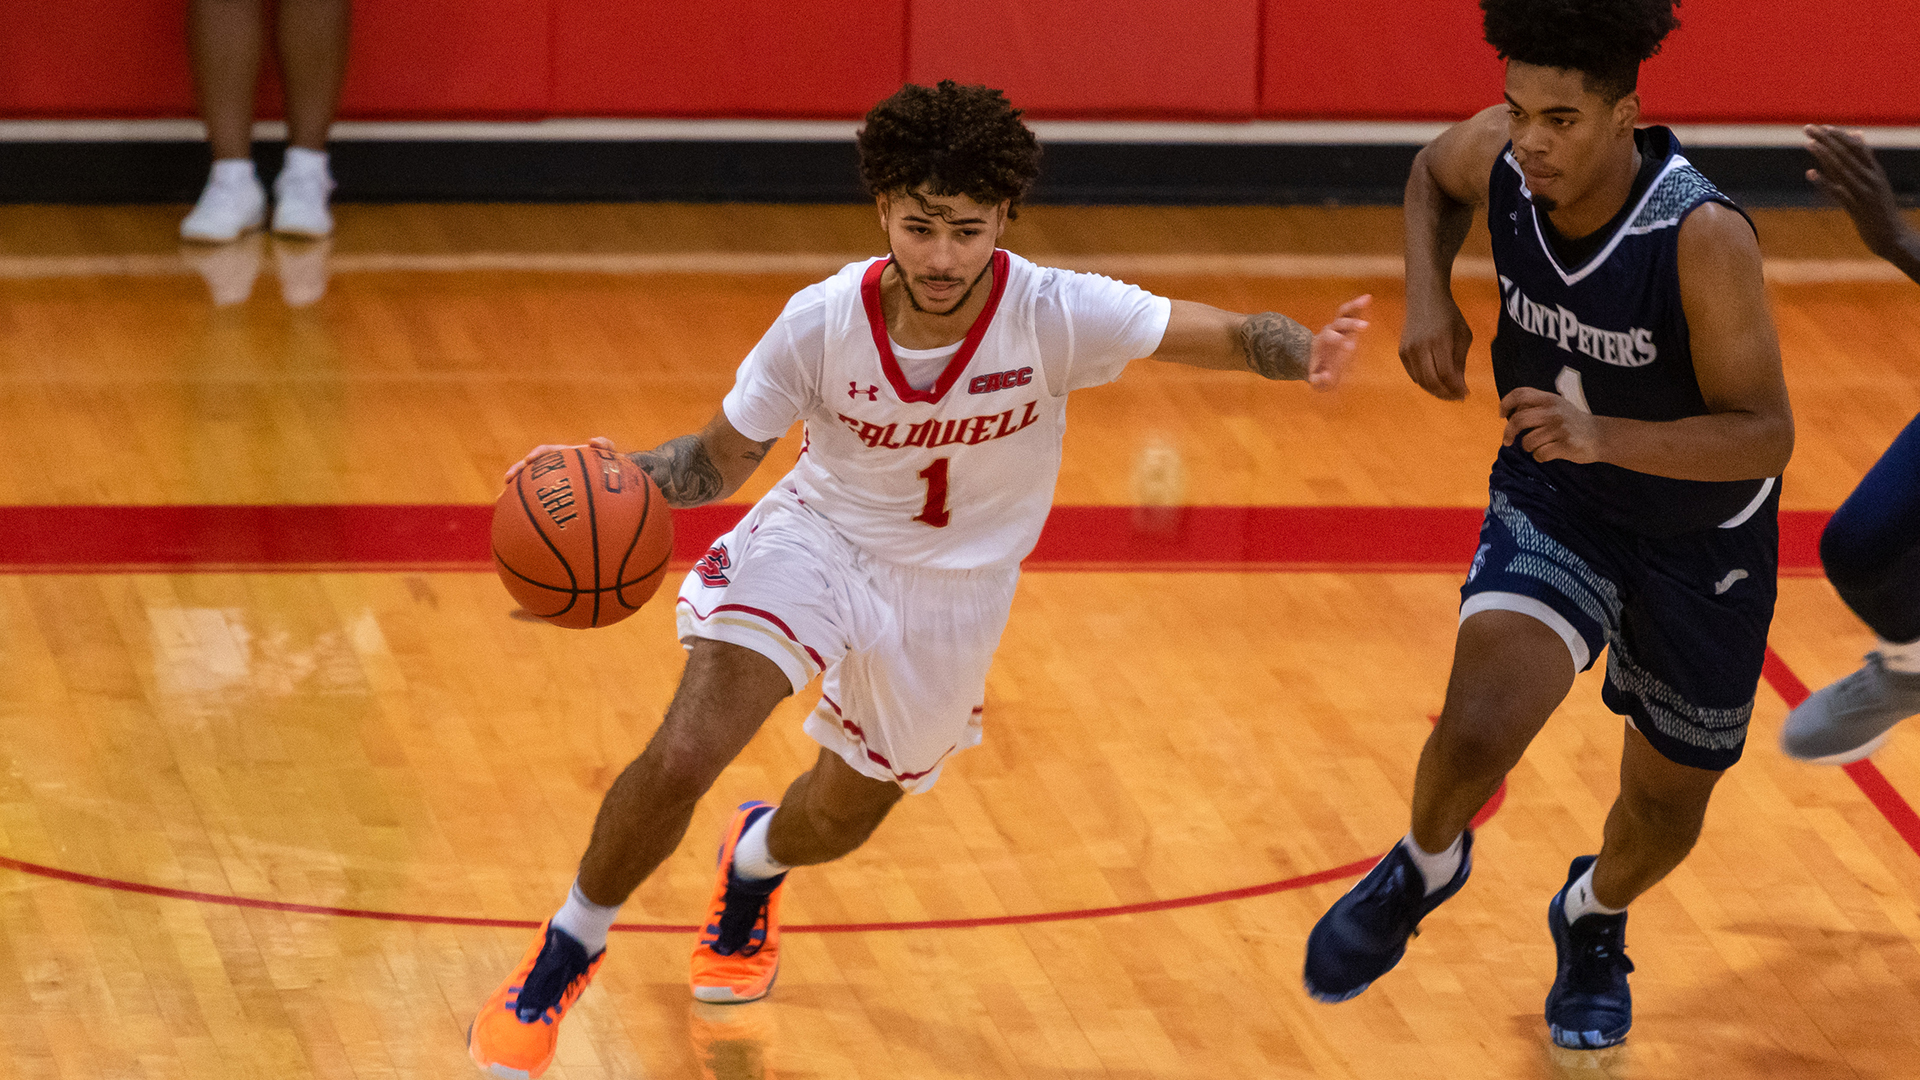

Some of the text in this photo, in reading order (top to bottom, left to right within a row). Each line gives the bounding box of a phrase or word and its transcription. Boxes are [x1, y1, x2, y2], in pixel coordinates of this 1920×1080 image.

[1499, 274, 1560, 341] AINT
[968, 366, 1033, 395] CACC
[531, 451, 577, 530] THE RO
[911, 457, 951, 529] 1
